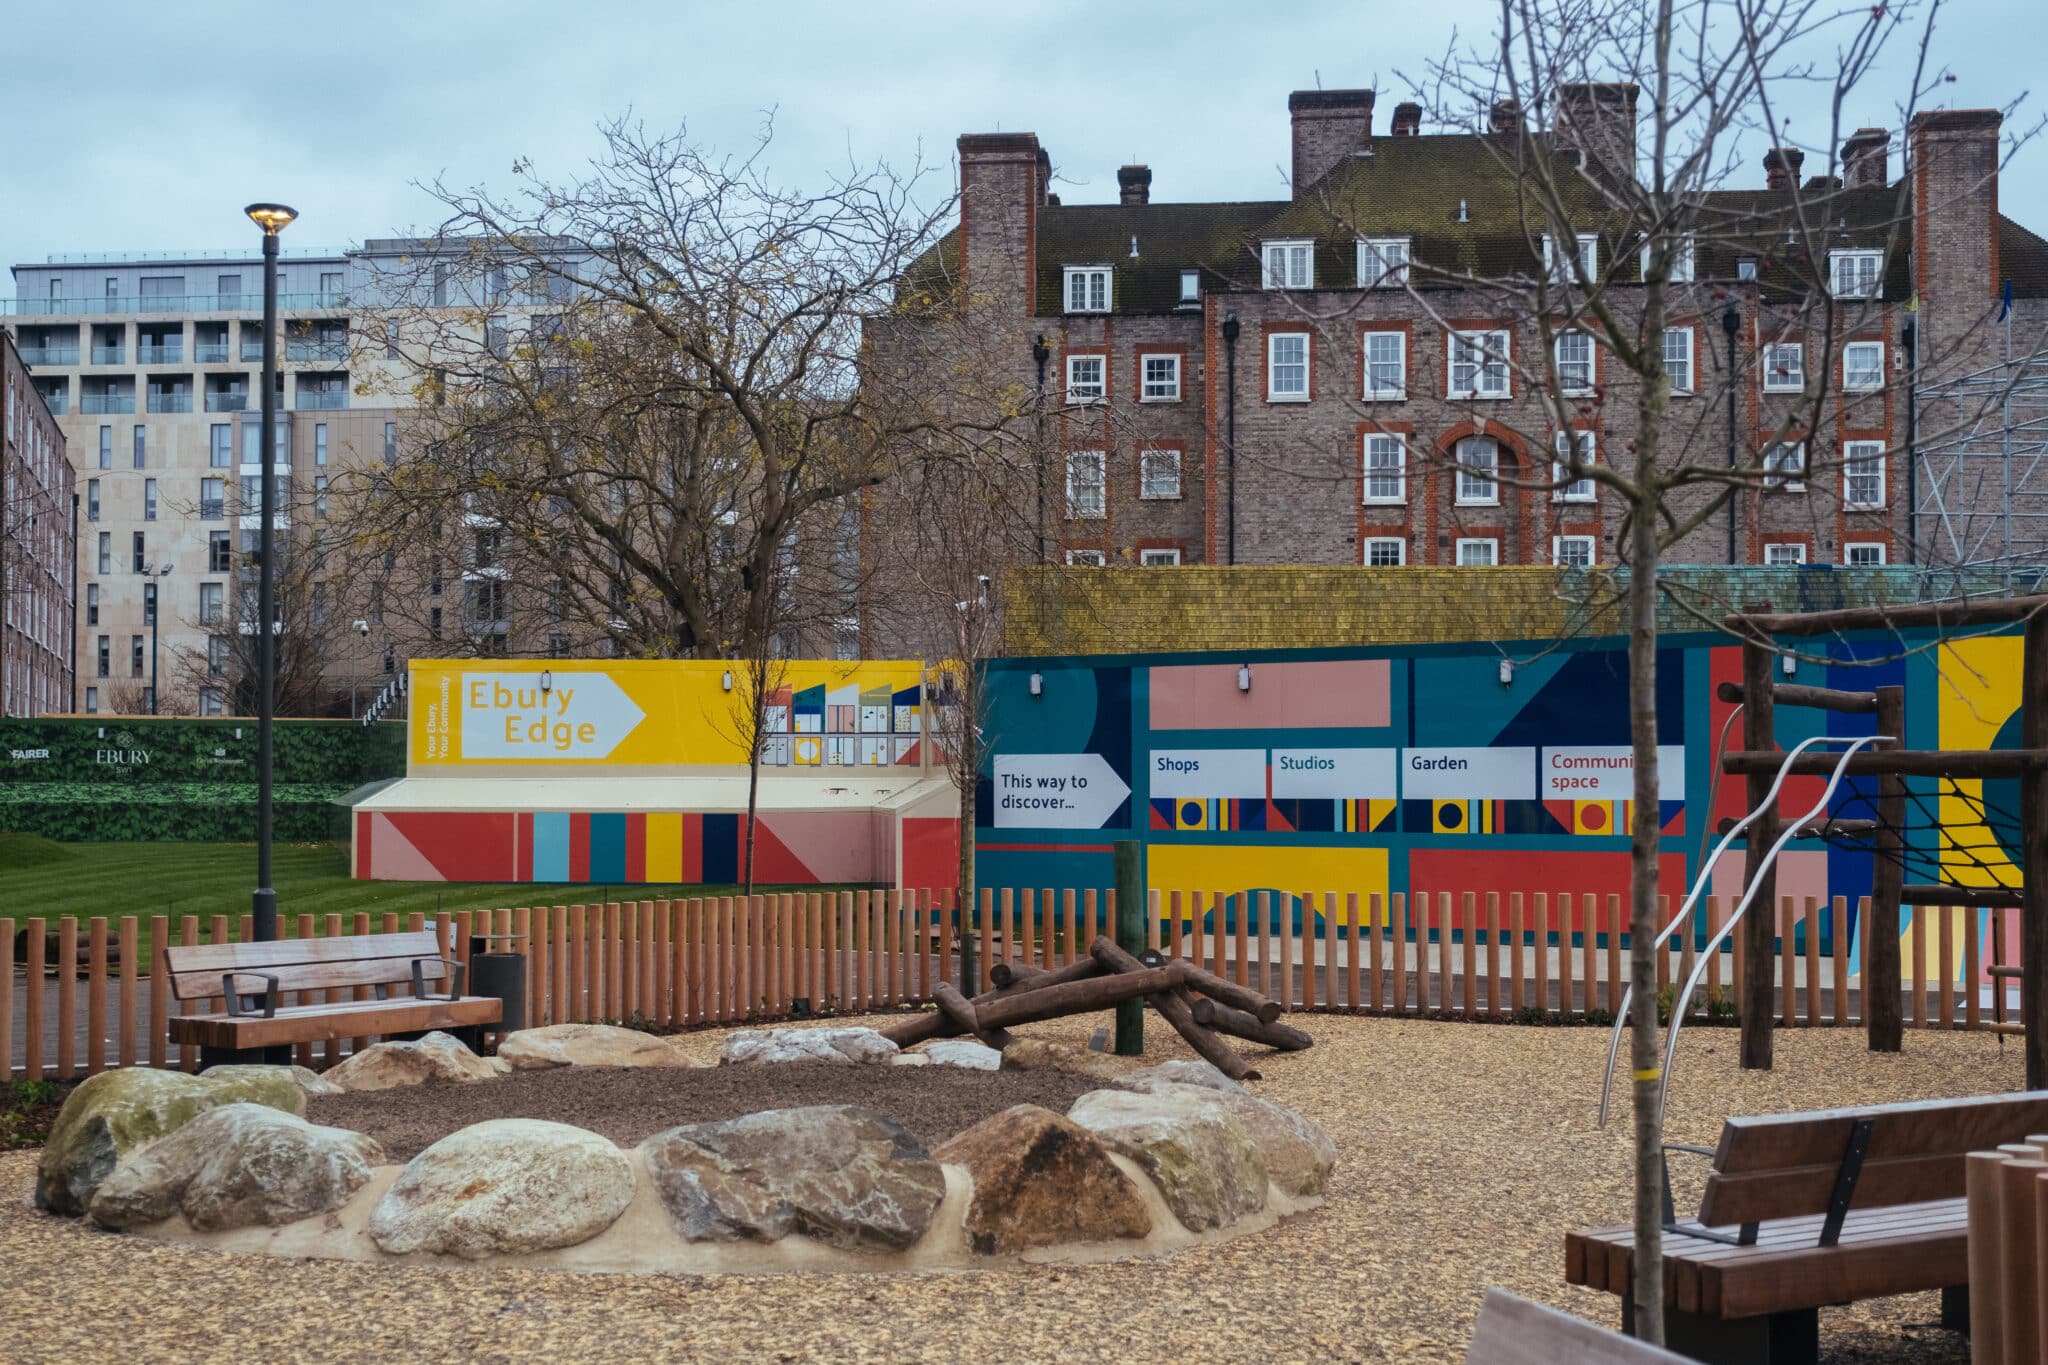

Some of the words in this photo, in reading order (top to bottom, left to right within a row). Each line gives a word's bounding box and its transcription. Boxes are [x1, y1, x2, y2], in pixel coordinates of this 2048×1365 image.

[439, 676, 450, 733] Community
[470, 681, 574, 716] Ebury
[505, 716, 596, 751] Edge
[426, 735, 437, 759] Your
[439, 735, 449, 759] Your
[96, 749, 153, 764] EBURY
[1157, 757, 1200, 774] Shops
[1279, 756, 1335, 771] Studios
[1411, 756, 1468, 771] Garden
[1551, 754, 1634, 769] Communi
[1001, 774, 1032, 789] This
[1036, 778, 1066, 793] way
[1071, 776, 1088, 789] to
[1551, 776, 1599, 792] space
